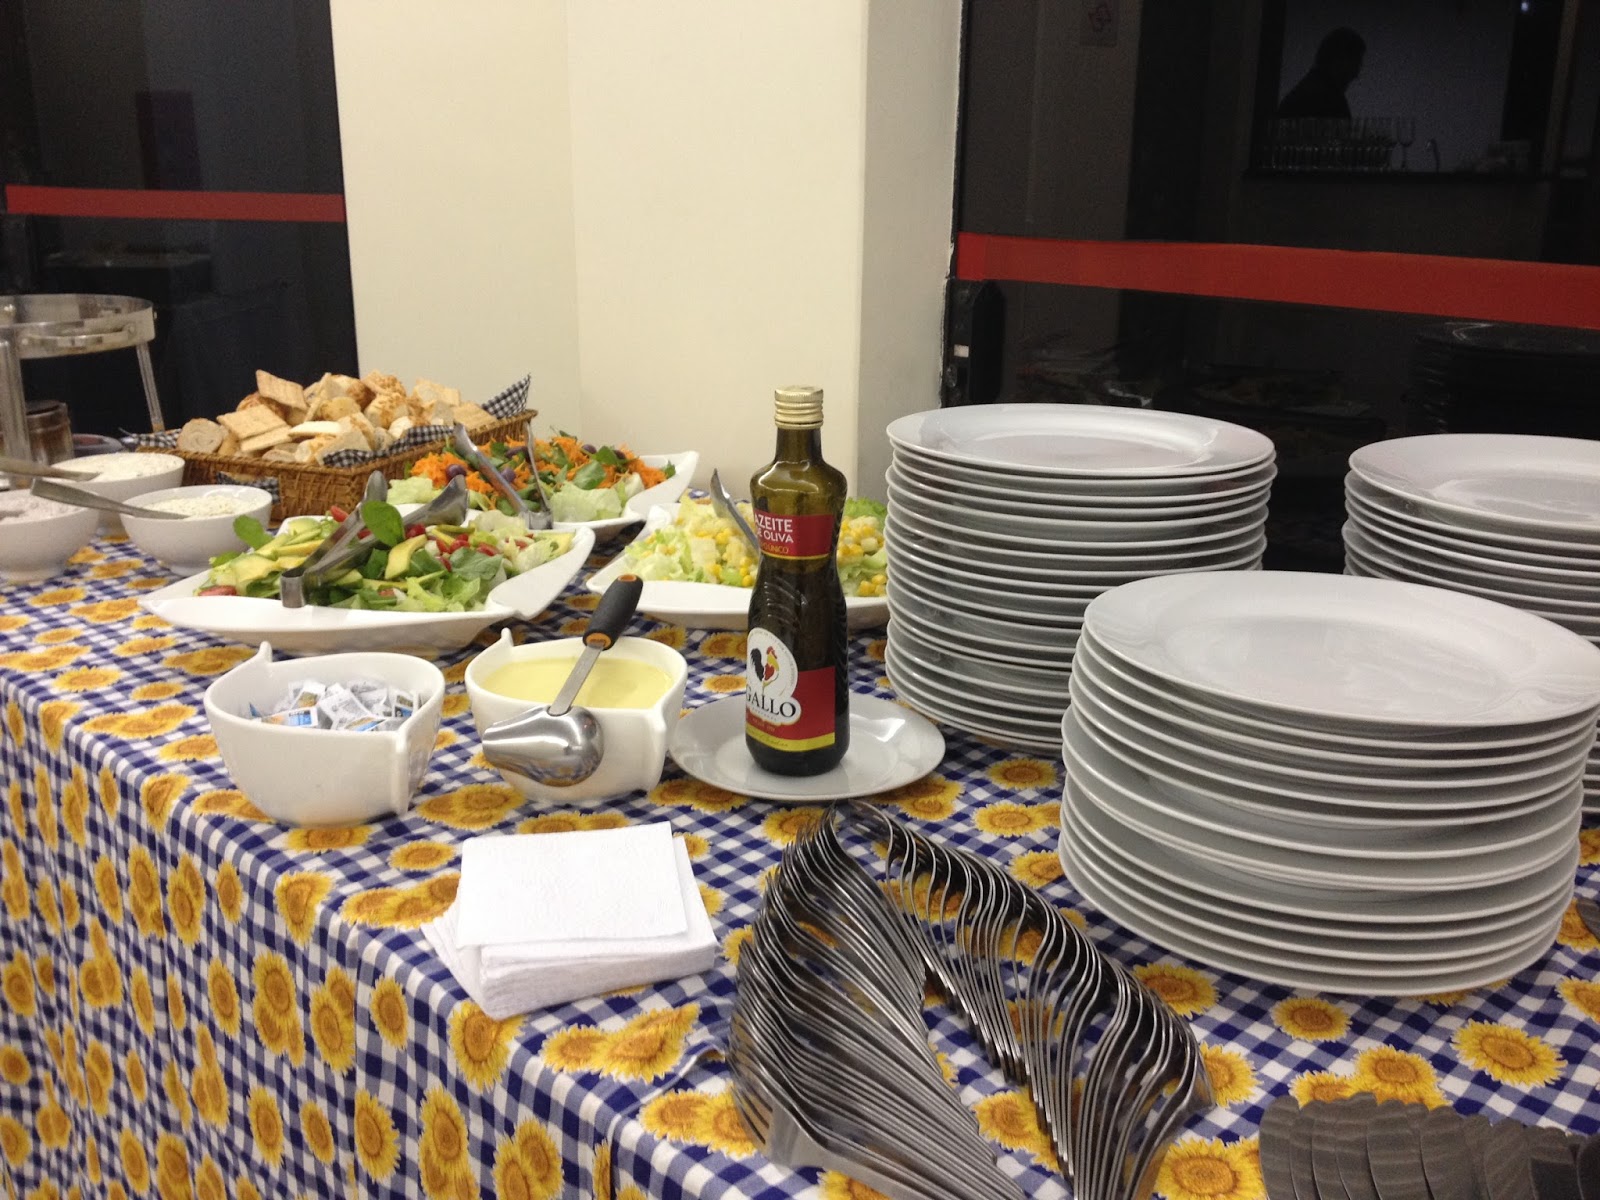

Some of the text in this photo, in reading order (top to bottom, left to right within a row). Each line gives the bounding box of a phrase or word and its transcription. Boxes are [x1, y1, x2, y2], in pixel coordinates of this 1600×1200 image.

[755, 513, 793, 533] AZEITE
[763, 530, 794, 543] OLIVA
[746, 684, 797, 718] GALLO
